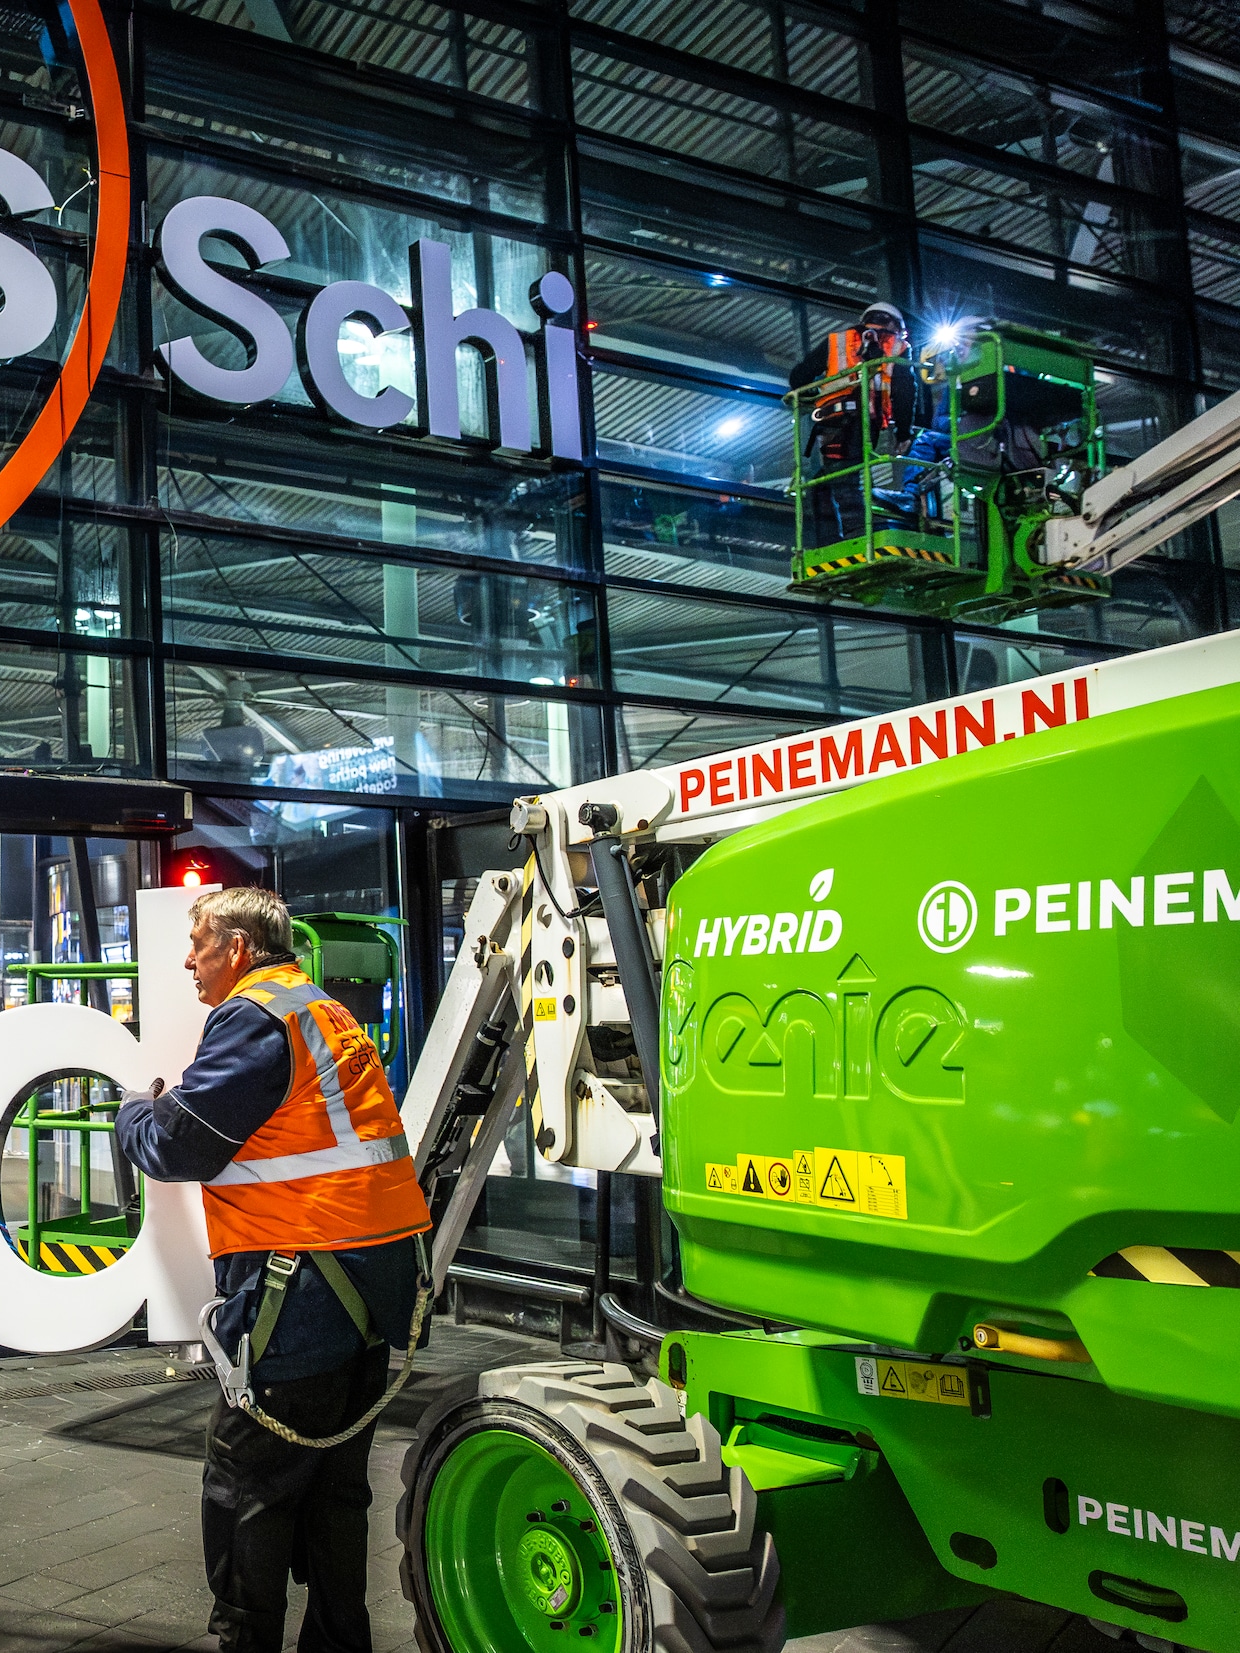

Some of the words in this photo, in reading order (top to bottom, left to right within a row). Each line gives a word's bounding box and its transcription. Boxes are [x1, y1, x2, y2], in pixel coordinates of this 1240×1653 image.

[158, 195, 583, 461] Schi
[693, 909, 842, 958] HYBRID
[993, 869, 1240, 937] PEINEM
[1078, 1495, 1240, 1562] PEINEM
